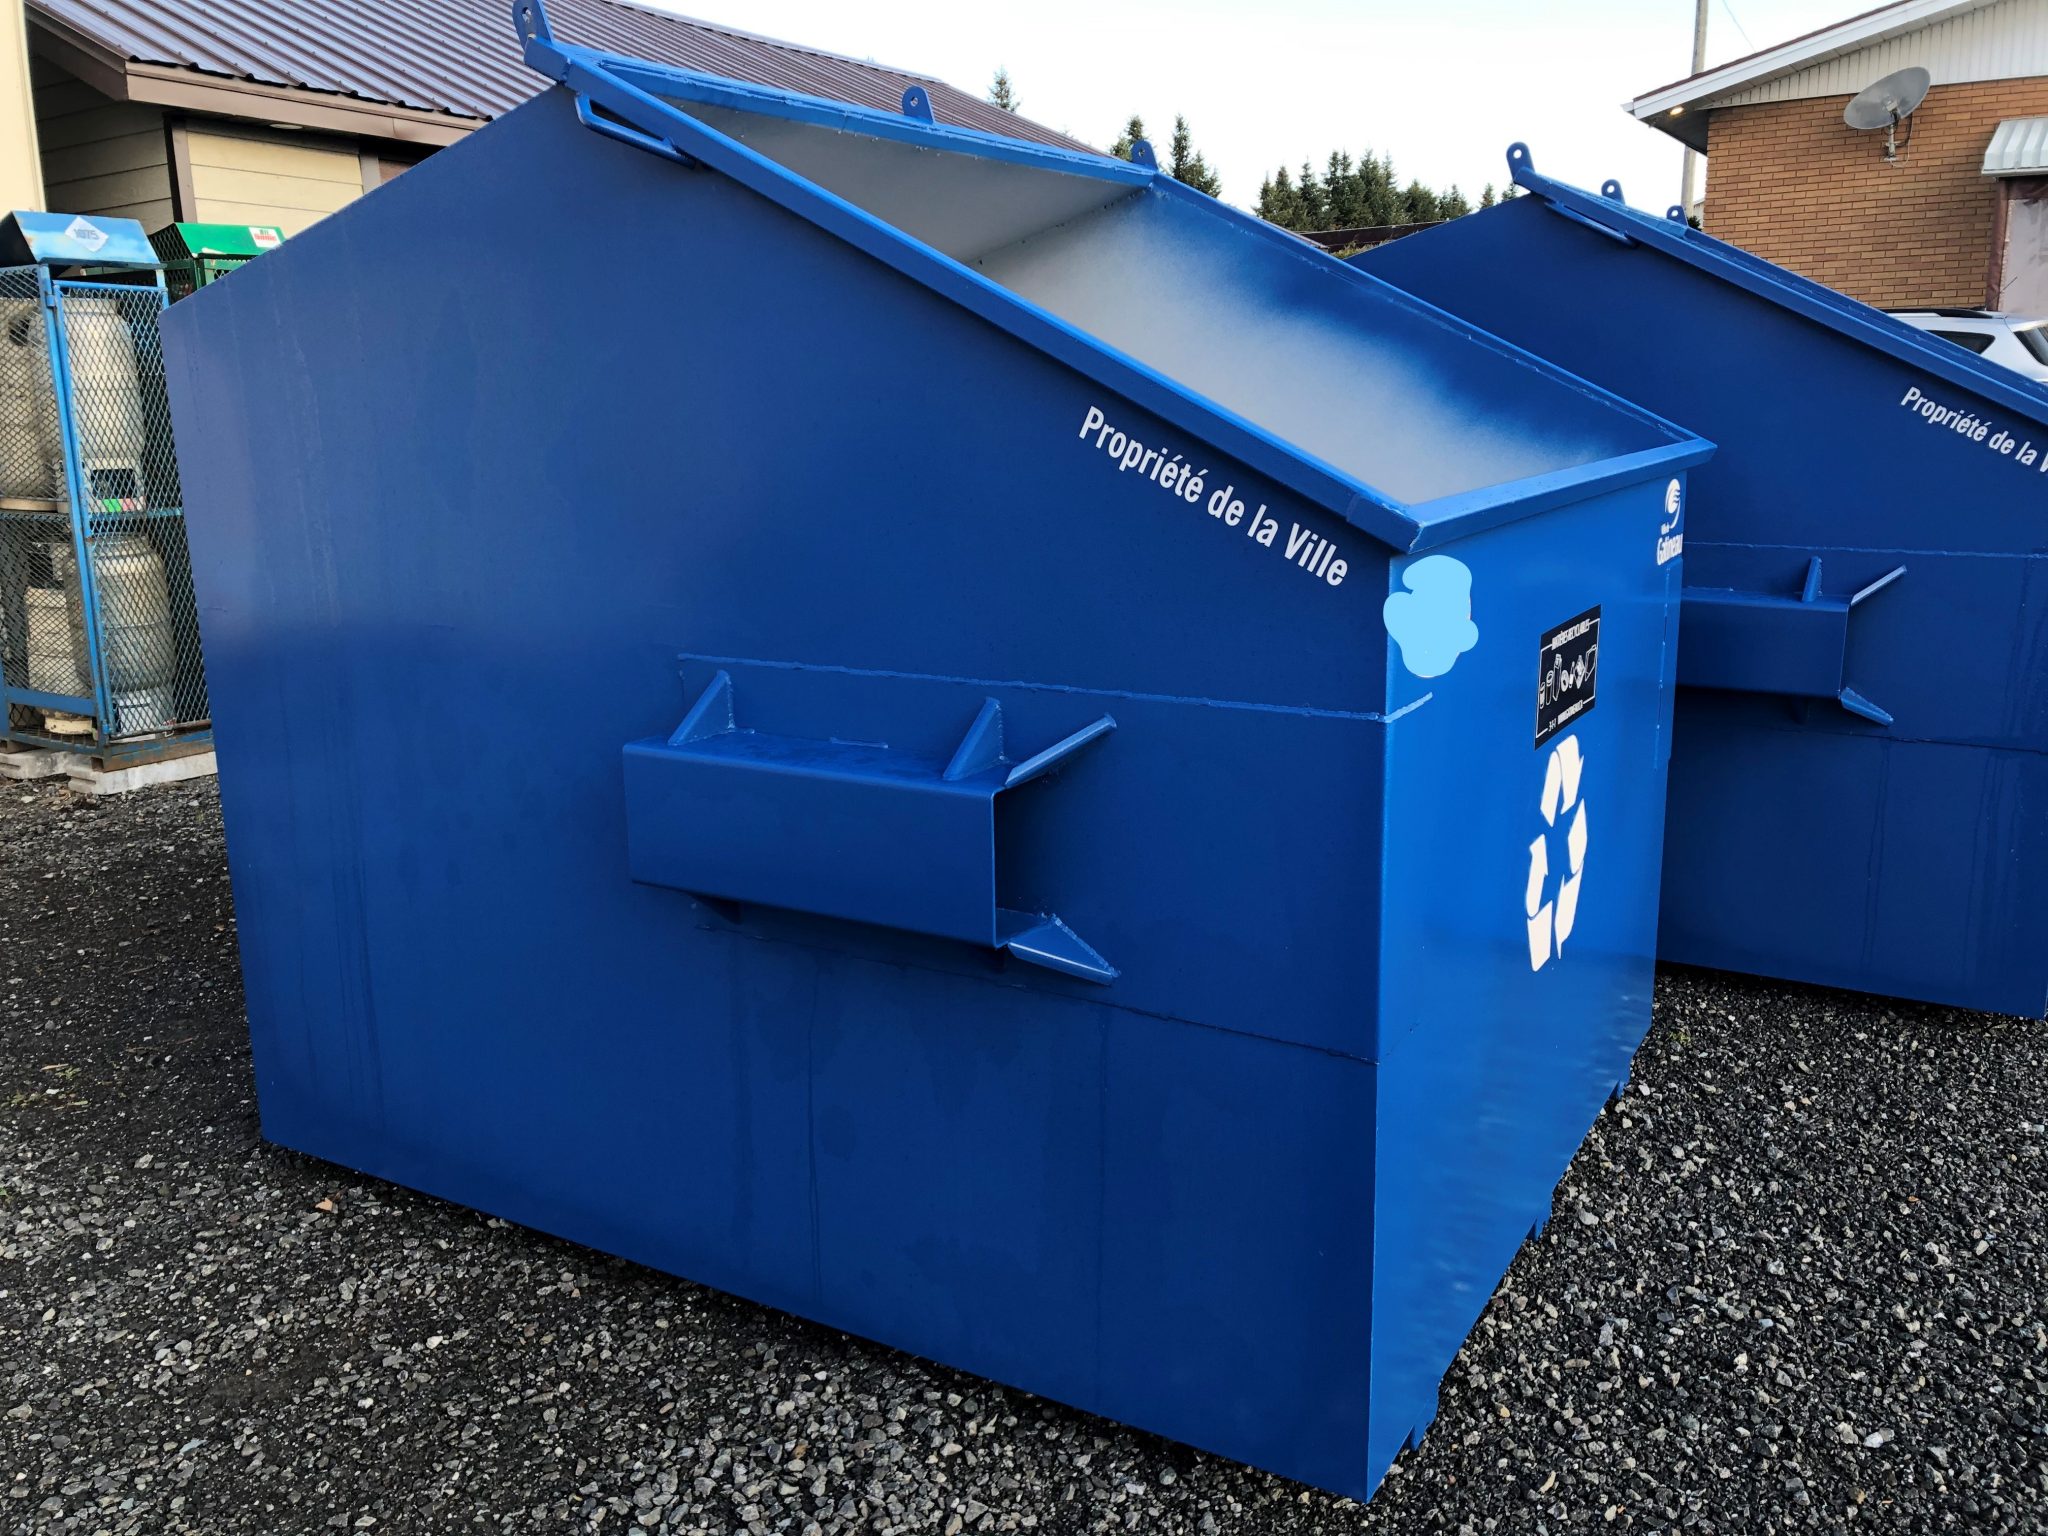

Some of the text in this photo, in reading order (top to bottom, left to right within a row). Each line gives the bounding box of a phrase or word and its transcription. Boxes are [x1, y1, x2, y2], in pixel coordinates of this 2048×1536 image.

[1900, 386, 1993, 442] Propriété
[1988, 430, 2016, 455] de
[2015, 440, 2038, 466] la
[1078, 405, 1348, 586] Propriété de la Ville
